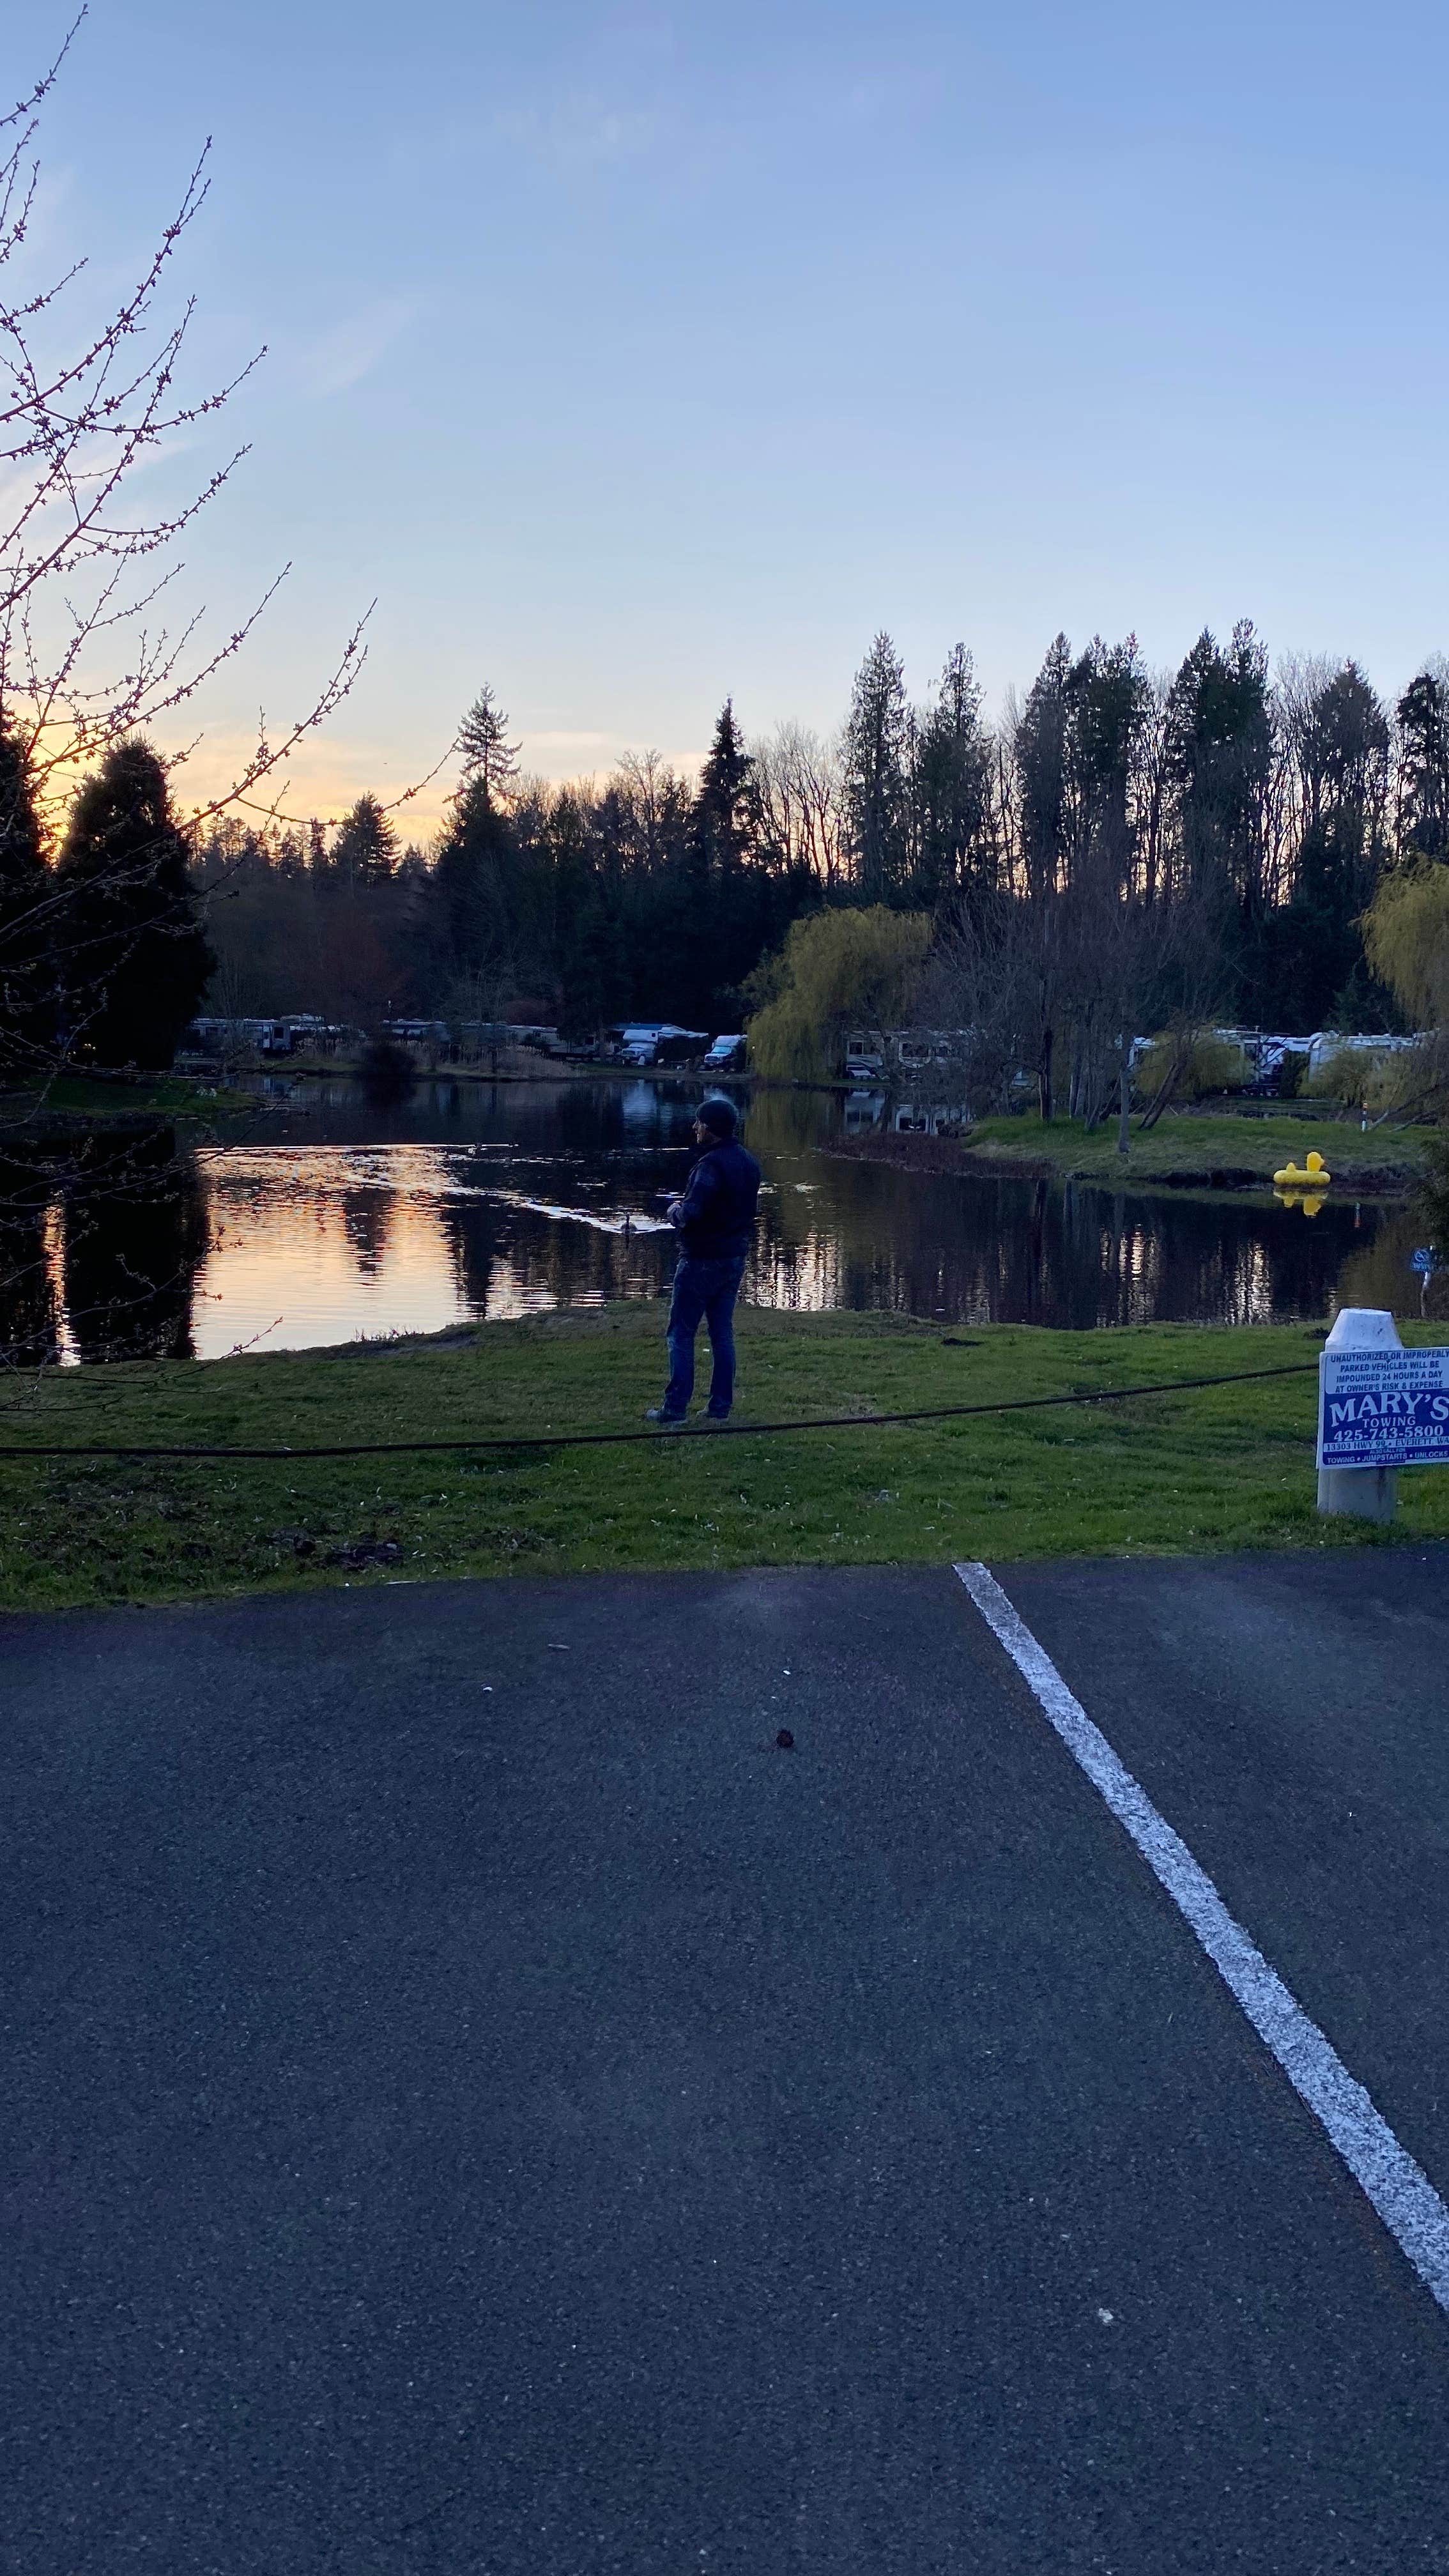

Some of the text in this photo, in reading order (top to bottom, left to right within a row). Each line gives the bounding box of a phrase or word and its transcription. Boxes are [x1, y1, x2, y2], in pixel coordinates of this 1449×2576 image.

[1331, 1353, 1388, 1363] UNAUTHORIZED
[1403, 1349, 1449, 1359] IMPROPERLY
[1340, 1363, 1369, 1372] PARKED
[1372, 1361, 1407, 1370] VEHICLES
[1336, 1373, 1380, 1383] IMPOUNDED
[1383, 1372, 1391, 1381] 24
[1393, 1371, 1419, 1380] HOURS
[1429, 1370, 1443, 1378] DAY
[1347, 1383, 1379, 1392] OWNER'S
[1382, 1382, 1399, 1390] RISK
[1409, 1380, 1443, 1390] EXPENSE
[1329, 1392, 1449, 1427] MARY'S
[1362, 1416, 1416, 1428] TOWING
[1334, 1425, 1443, 1442] 425-743-5800
[1327, 1443, 1351, 1451] 13303
[1354, 1441, 1372, 1450] HWY
[1395, 1437, 1432, 1446] EVERETT
[1362, 1453, 1407, 1462] JUMPSTARTS
[1414, 1450, 1448, 1459] UNLOCKS
